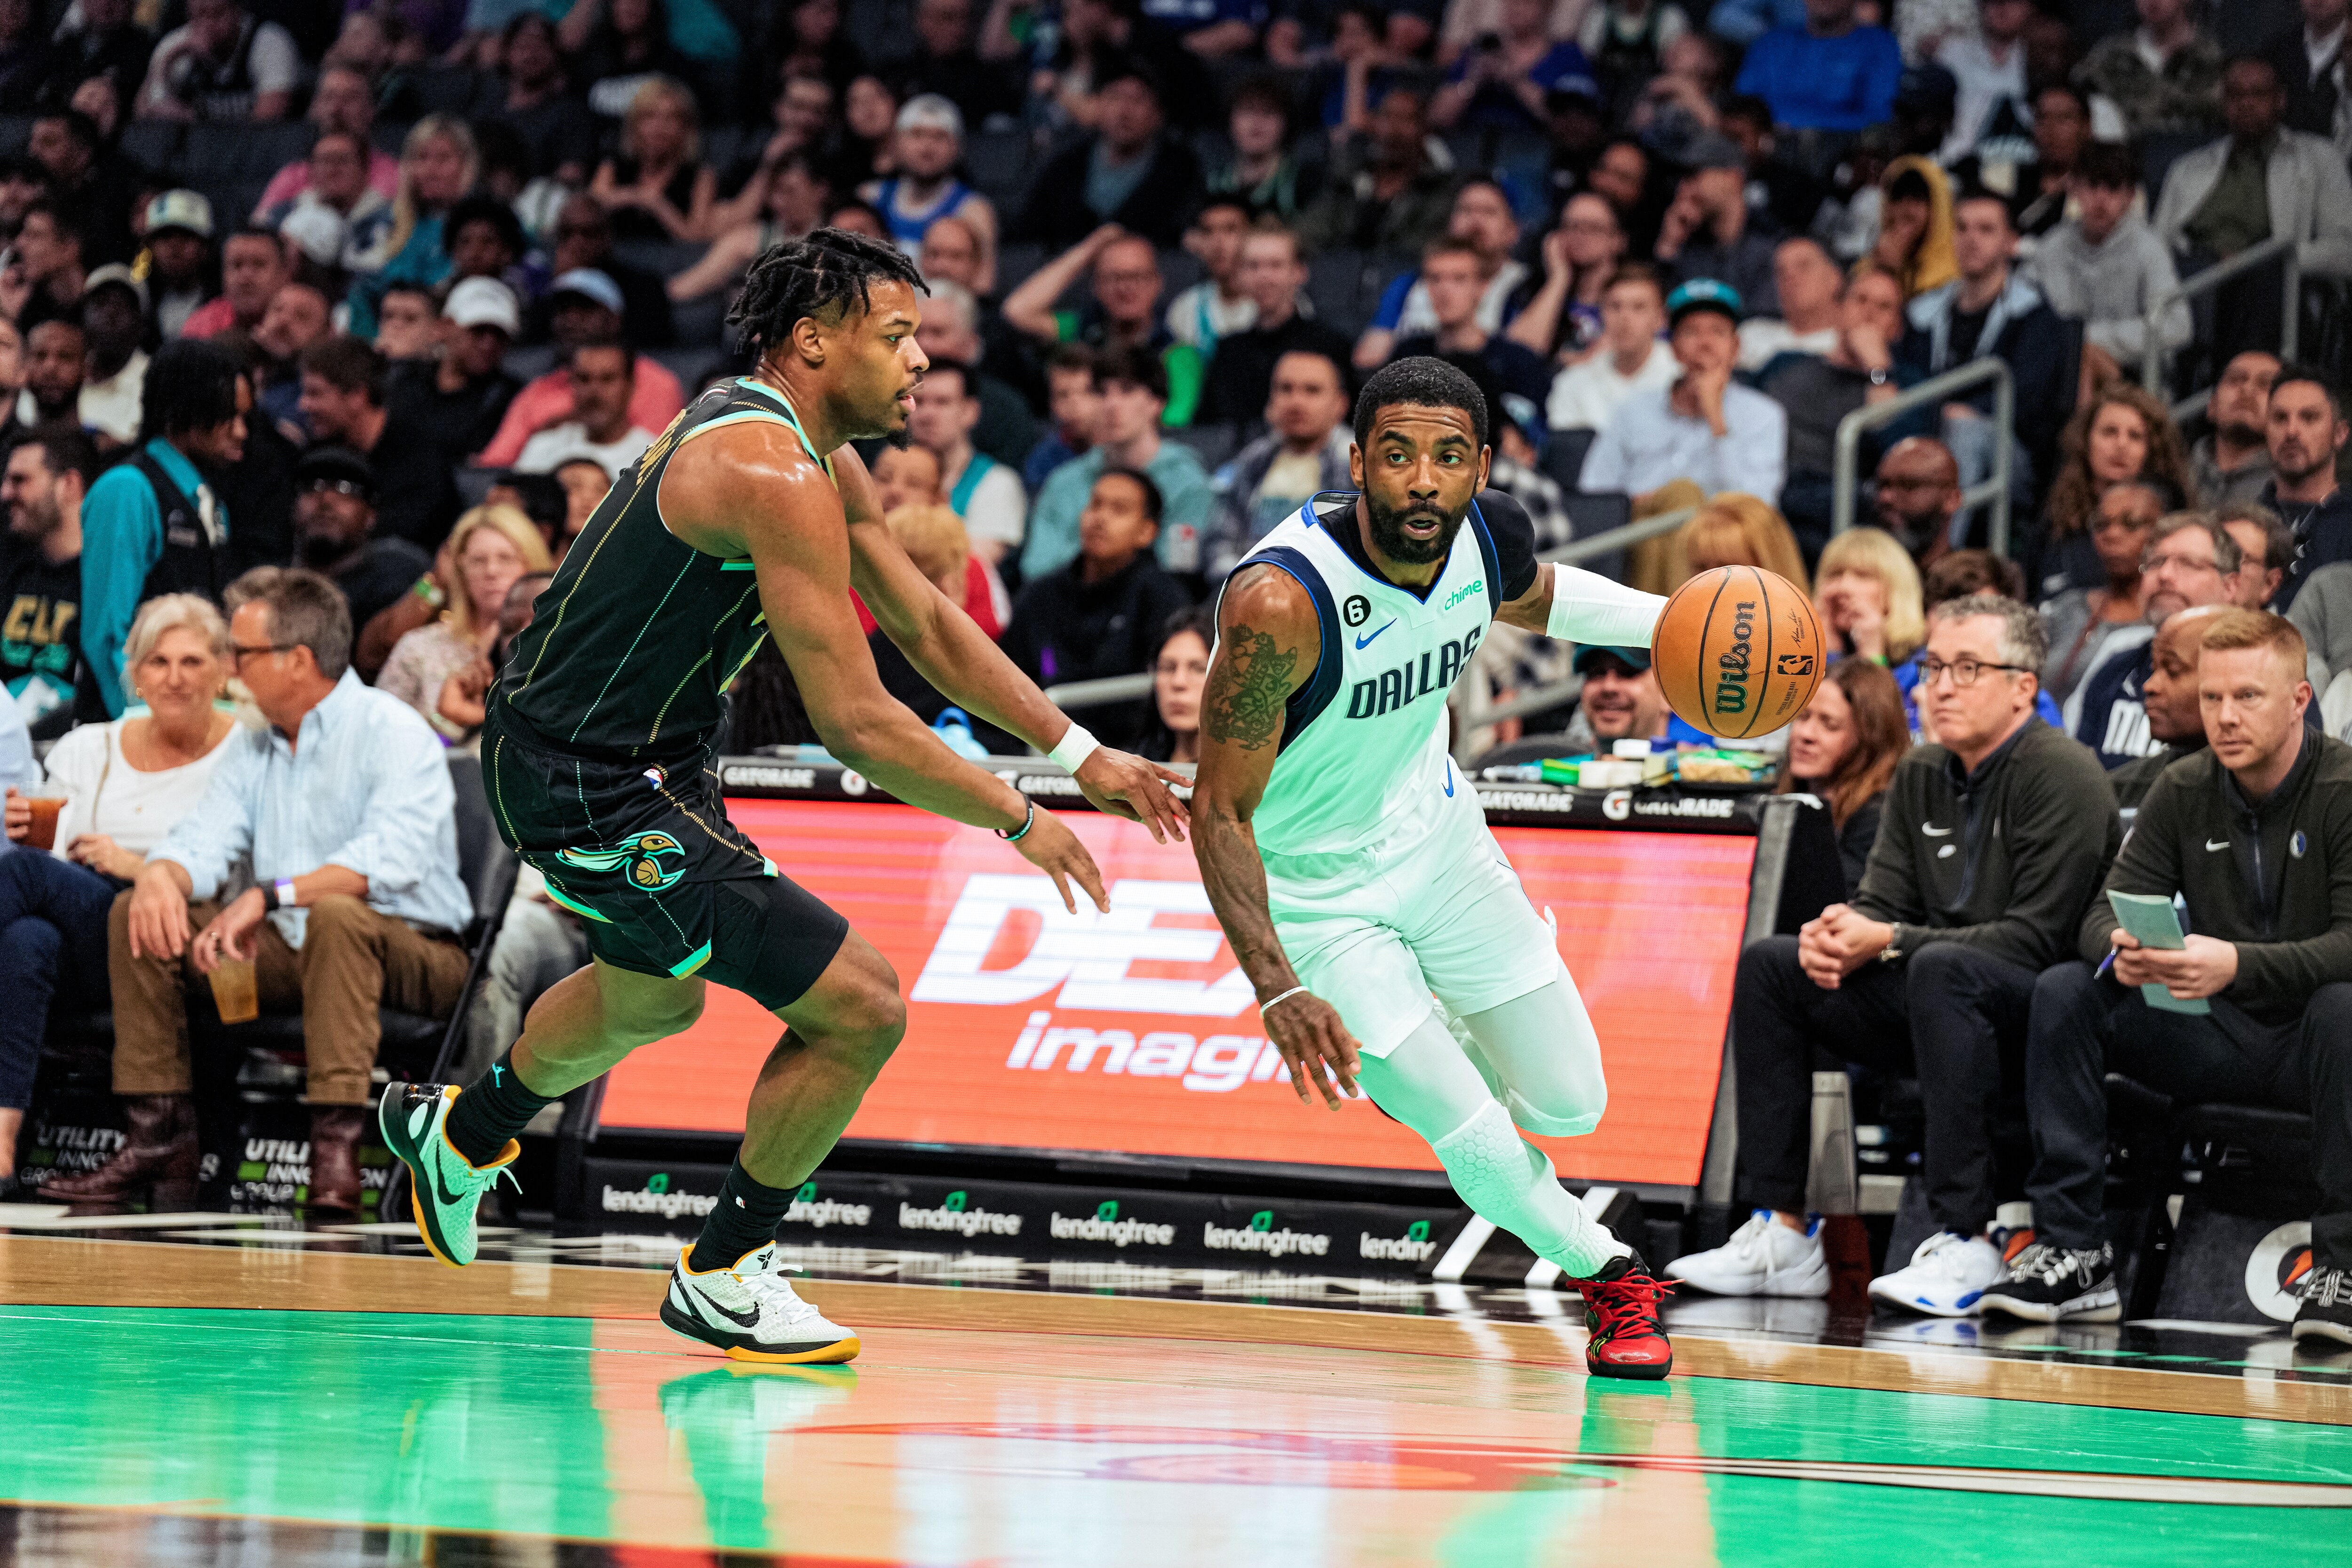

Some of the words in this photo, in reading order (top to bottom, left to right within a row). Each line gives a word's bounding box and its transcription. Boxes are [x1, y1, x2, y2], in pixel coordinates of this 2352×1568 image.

[1445, 580, 1483, 611] chime
[1347, 599, 1365, 624] 6
[1344, 622, 1483, 720] DALLAS
[1715, 601, 1756, 714] Wilson
[1788, 681, 1796, 691] BALL
[723, 766, 815, 788] GATORADE
[1017, 776, 1083, 795] GATOR
[1478, 790, 1574, 812] GATORADE
[245, 1138, 311, 1164] UTILI
[899, 1201, 1022, 1237] lendingtree
[1050, 1211, 1176, 1247] lendingtree
[1204, 1221, 1329, 1258] lendingtree
